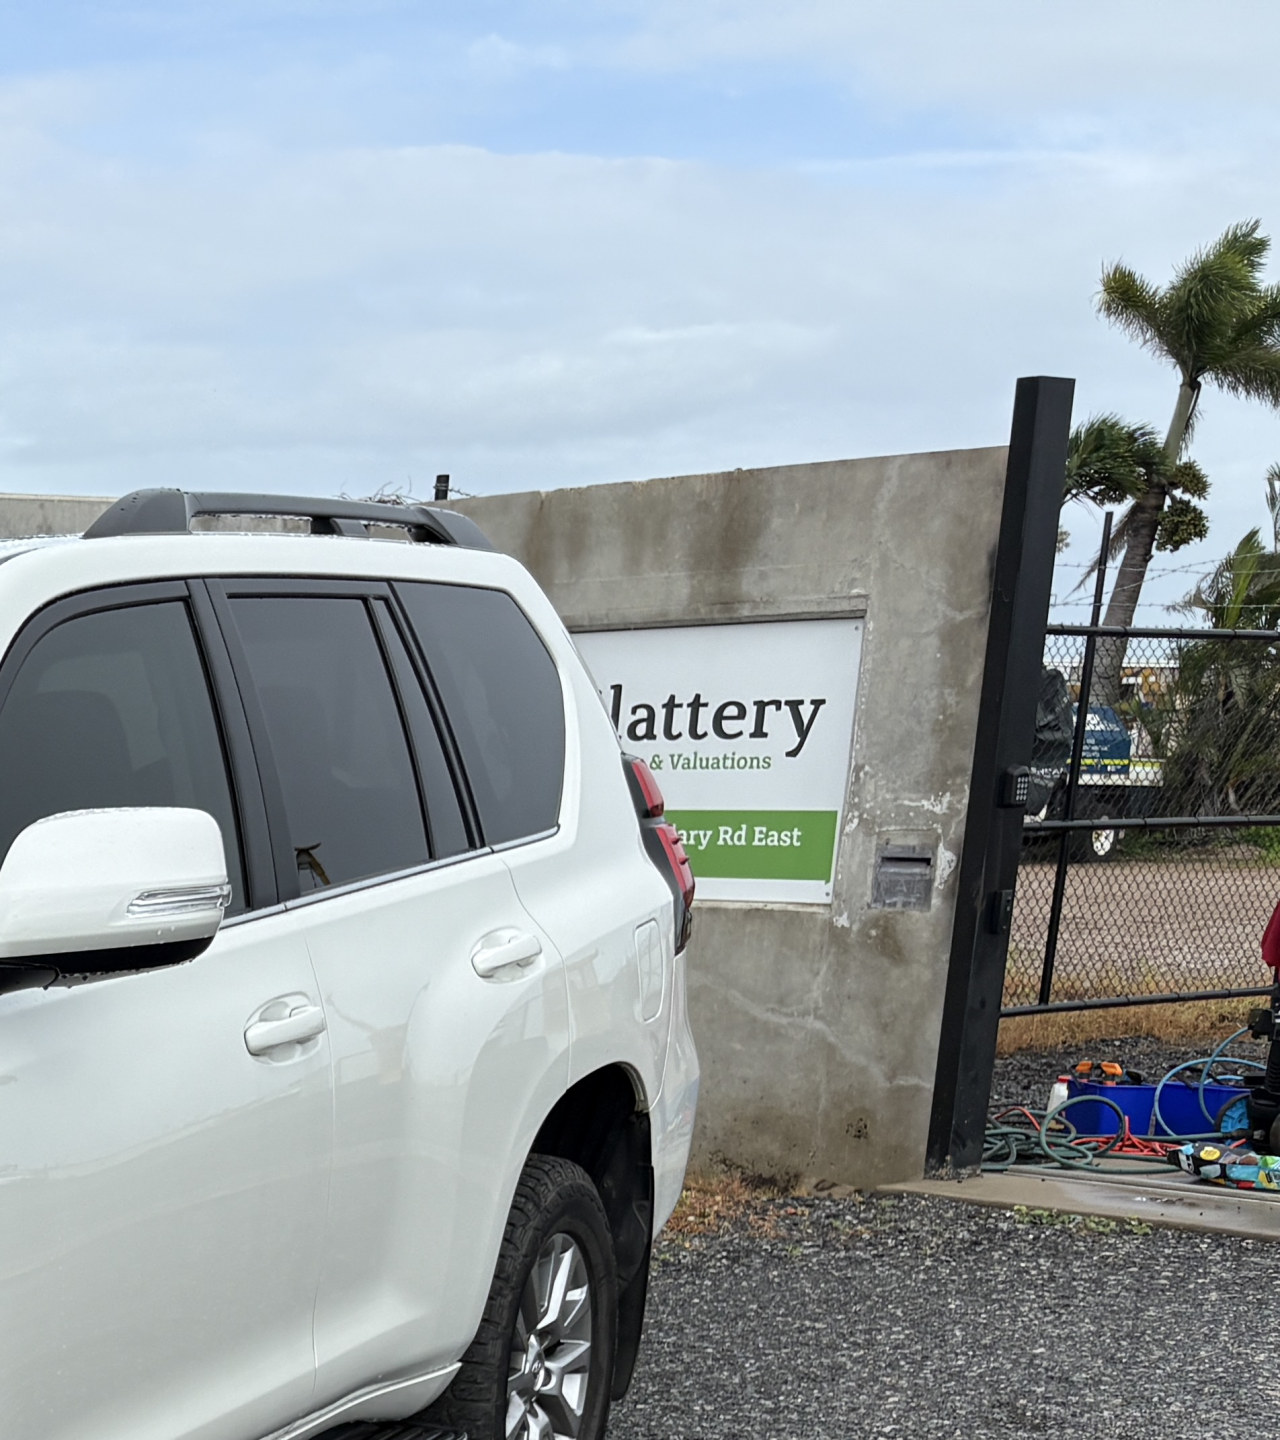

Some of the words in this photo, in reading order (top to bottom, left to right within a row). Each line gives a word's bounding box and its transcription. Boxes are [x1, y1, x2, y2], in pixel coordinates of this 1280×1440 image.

[608, 684, 827, 758] lattery
[649, 754, 664, 770] &
[669, 752, 772, 770] Valuations
[717, 824, 747, 847] Rd
[752, 826, 802, 848] East
